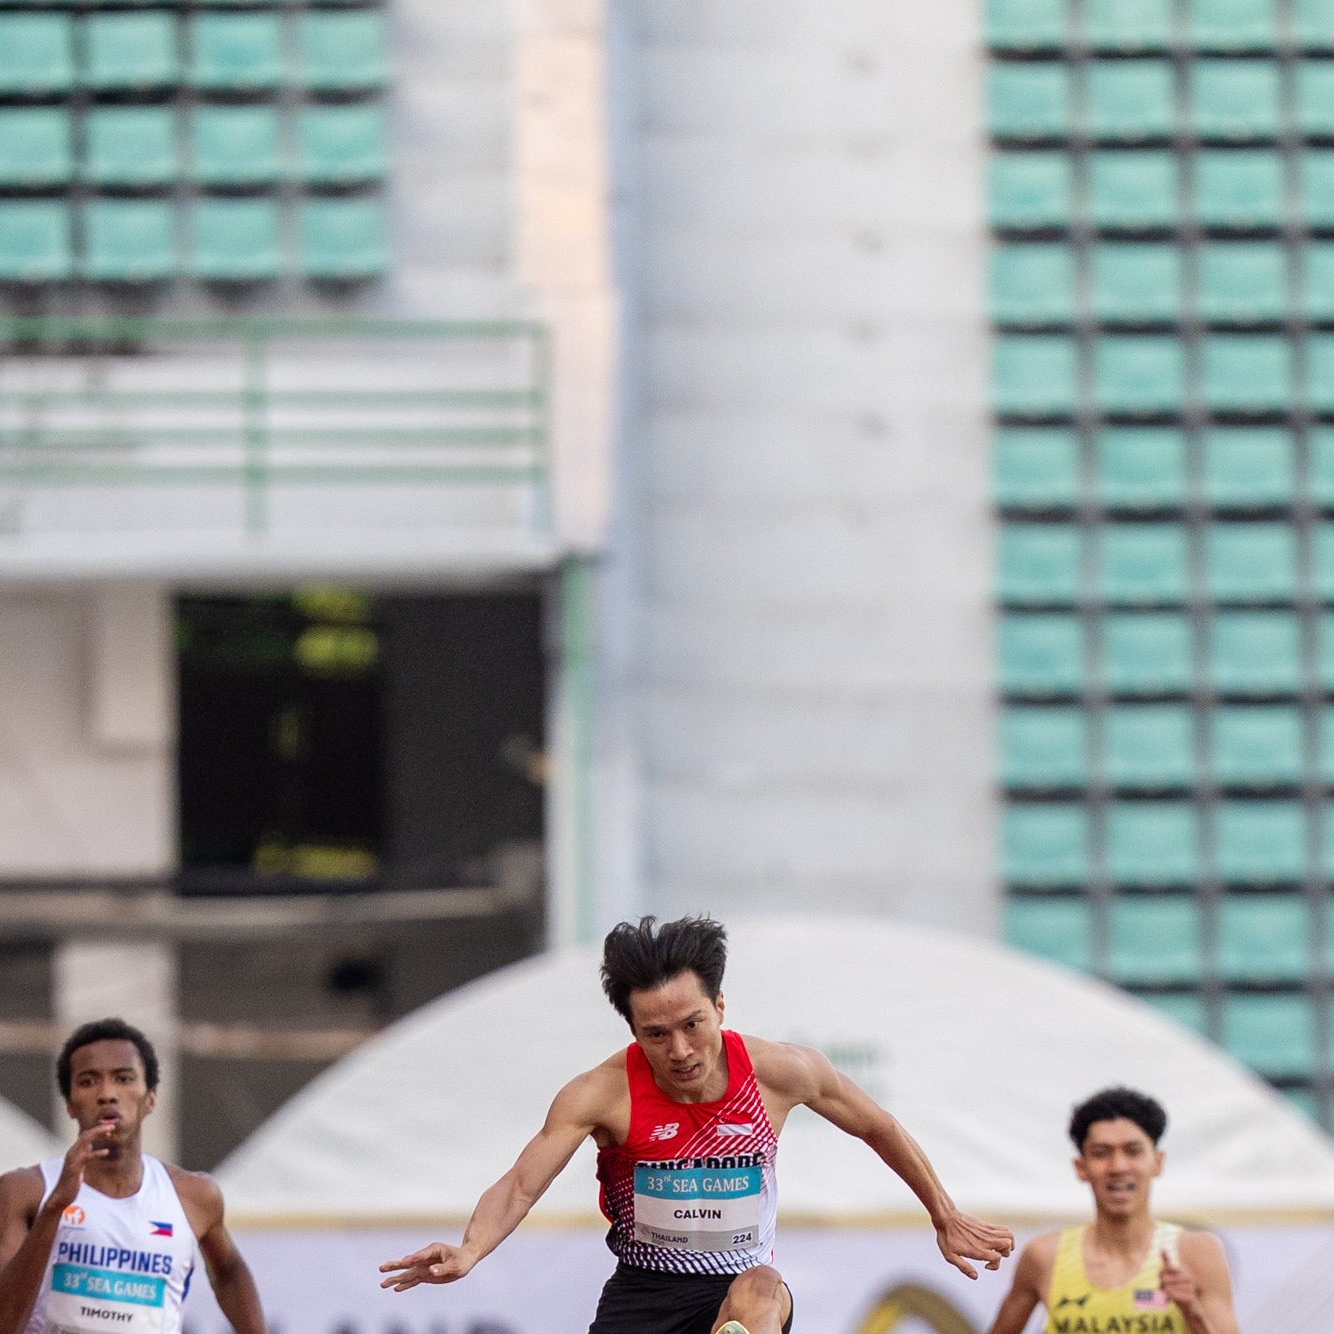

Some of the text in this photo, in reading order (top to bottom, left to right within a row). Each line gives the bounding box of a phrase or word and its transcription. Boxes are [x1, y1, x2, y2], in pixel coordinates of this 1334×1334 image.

[673, 1178, 698, 1193] SEA
[702, 1176, 749, 1192] GAMES
[673, 1209, 722, 1219] CALVIN
[651, 1231, 688, 1243] THAILAND
[732, 1233, 752, 1244] 224
[59, 1241, 173, 1275] PHILIPPINES
[87, 1275, 111, 1293] SEA
[113, 1280, 157, 1300] GAMES
[80, 1306, 134, 1323] TIMOTHY
[1054, 1315, 1174, 1333] MALAYSIA
